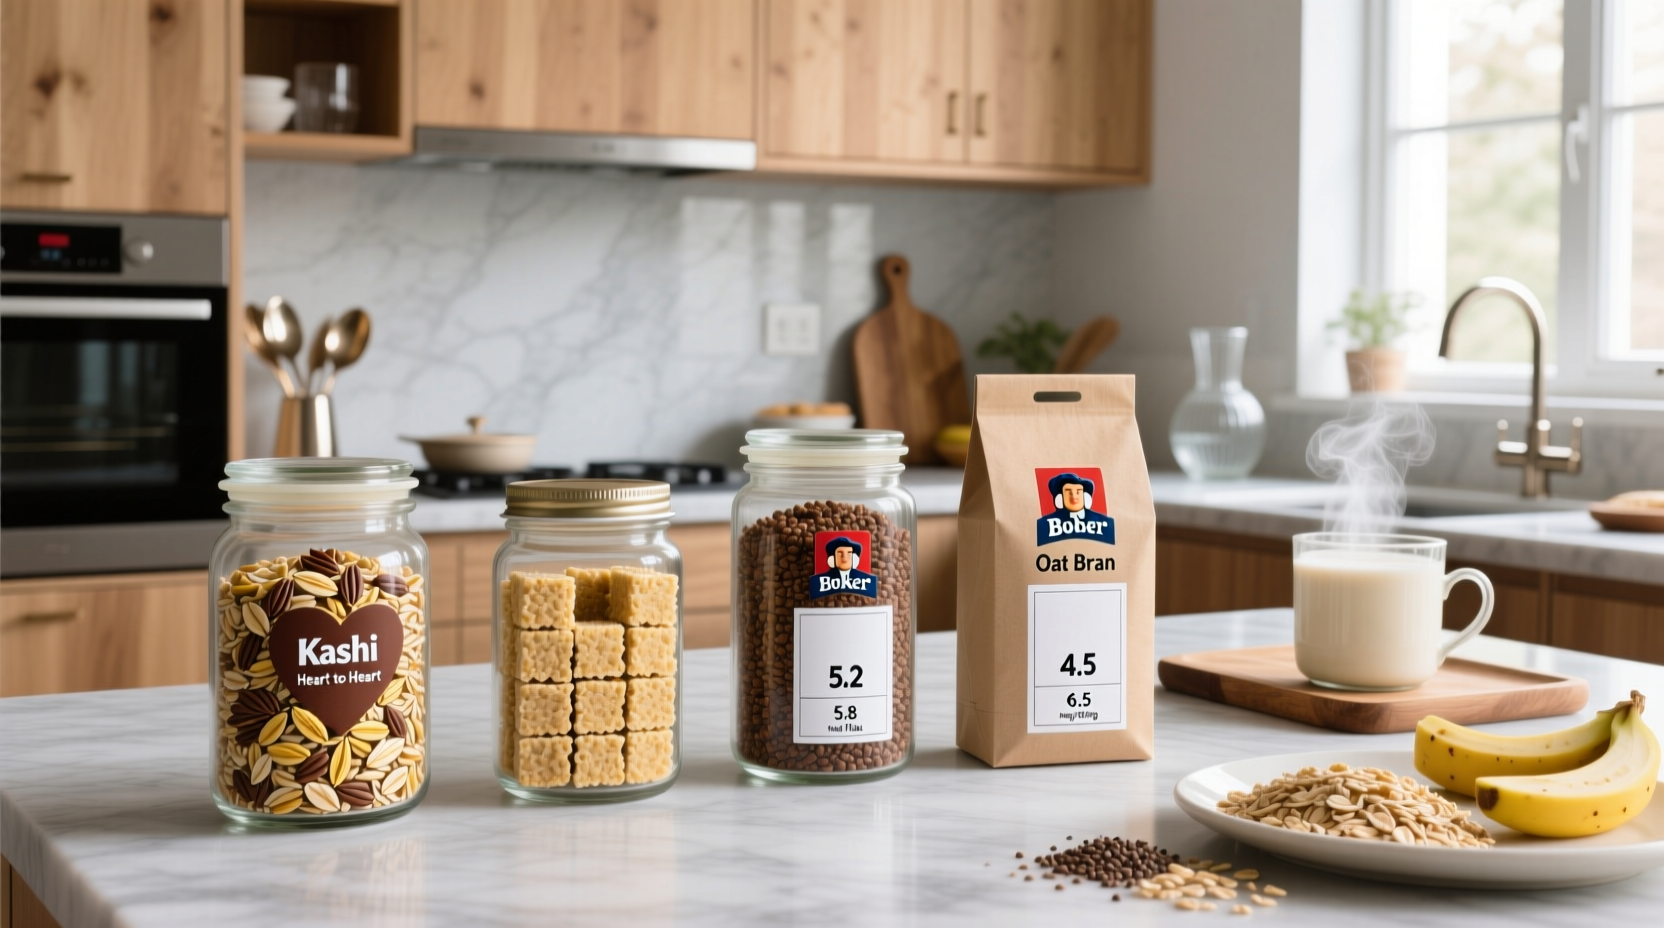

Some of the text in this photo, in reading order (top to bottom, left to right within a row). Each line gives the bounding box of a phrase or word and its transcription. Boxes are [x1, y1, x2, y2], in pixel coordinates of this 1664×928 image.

[1036, 553, 1115, 572] Oat Bran
[819, 575, 872, 592] Boker
[298, 633, 378, 666] Kashi
[1060, 652, 1096, 677] 4.5
[297, 670, 382, 686] Heart to Heart
[829, 664, 863, 689] 5.2
[1066, 692, 1091, 708] 6.5
